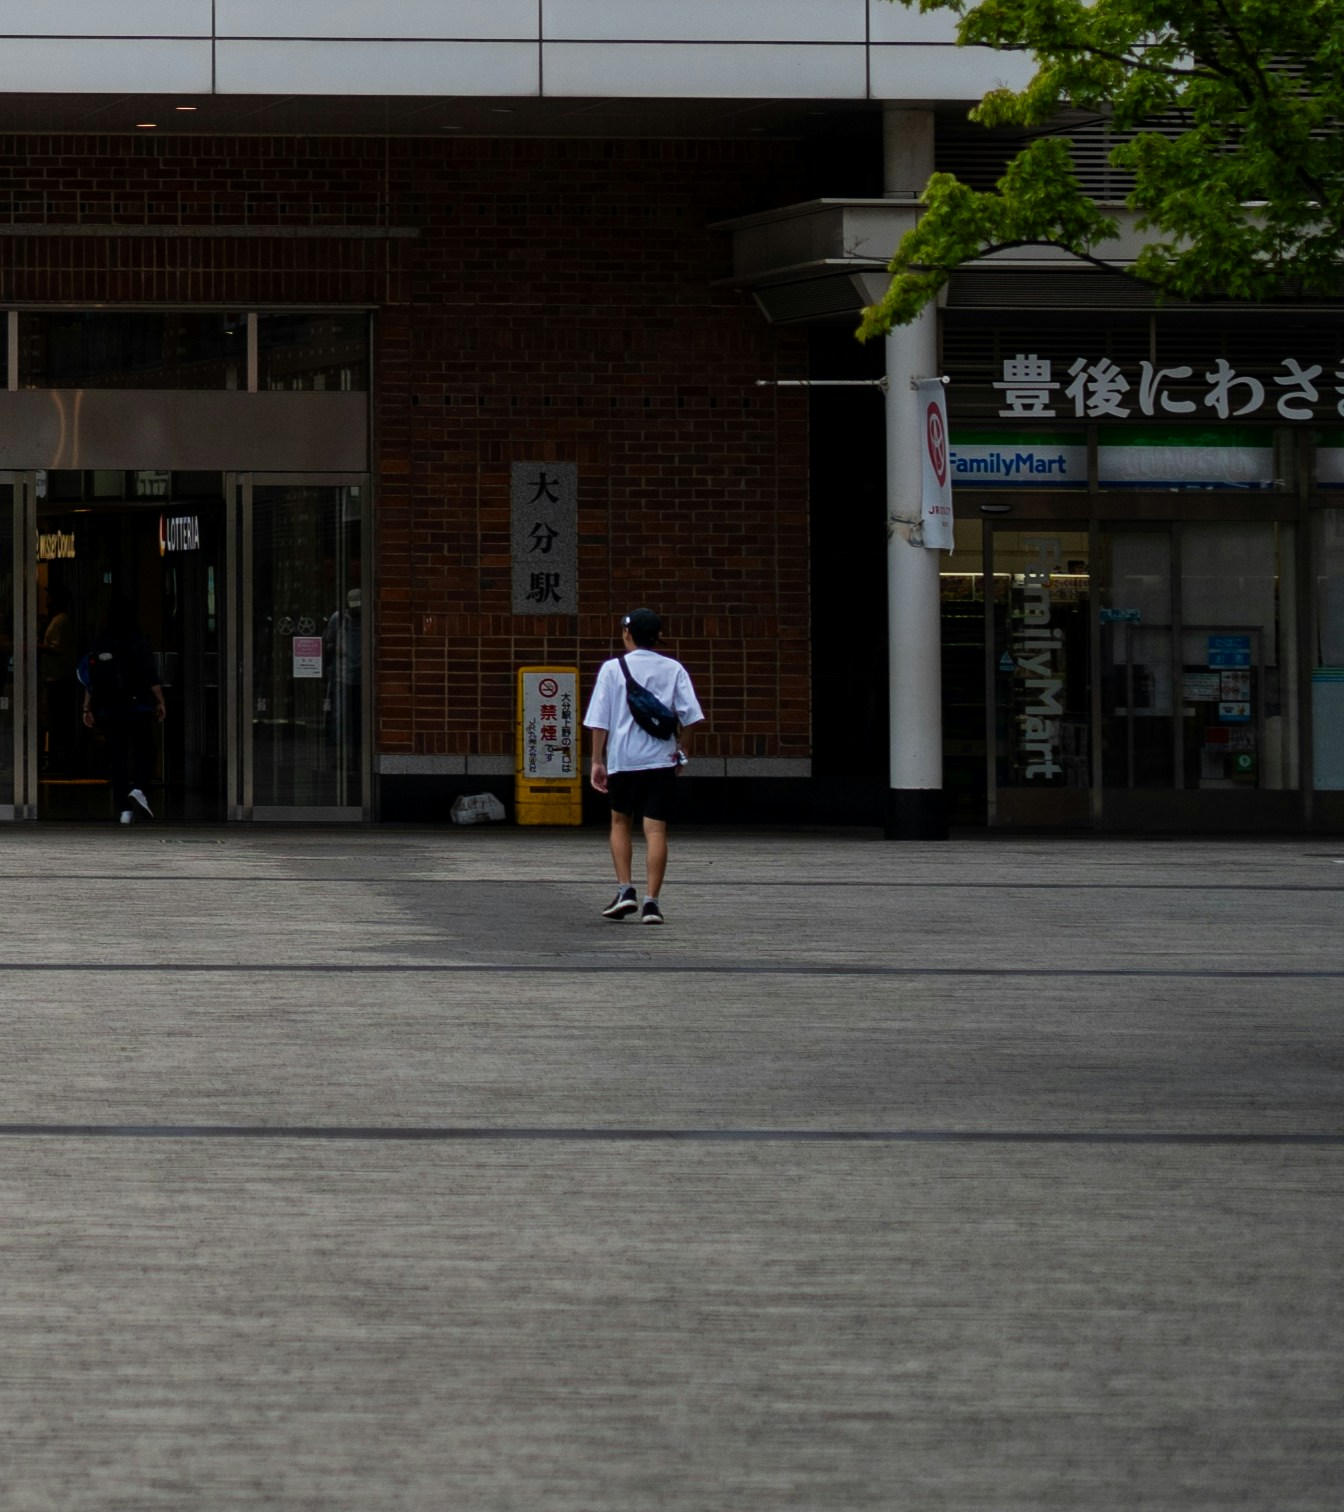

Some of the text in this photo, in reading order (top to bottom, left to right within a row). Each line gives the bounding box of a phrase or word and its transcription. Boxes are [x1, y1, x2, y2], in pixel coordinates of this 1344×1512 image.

[166, 515, 200, 552] LOTTERIA
[526, 471, 563, 603] 大分駅
